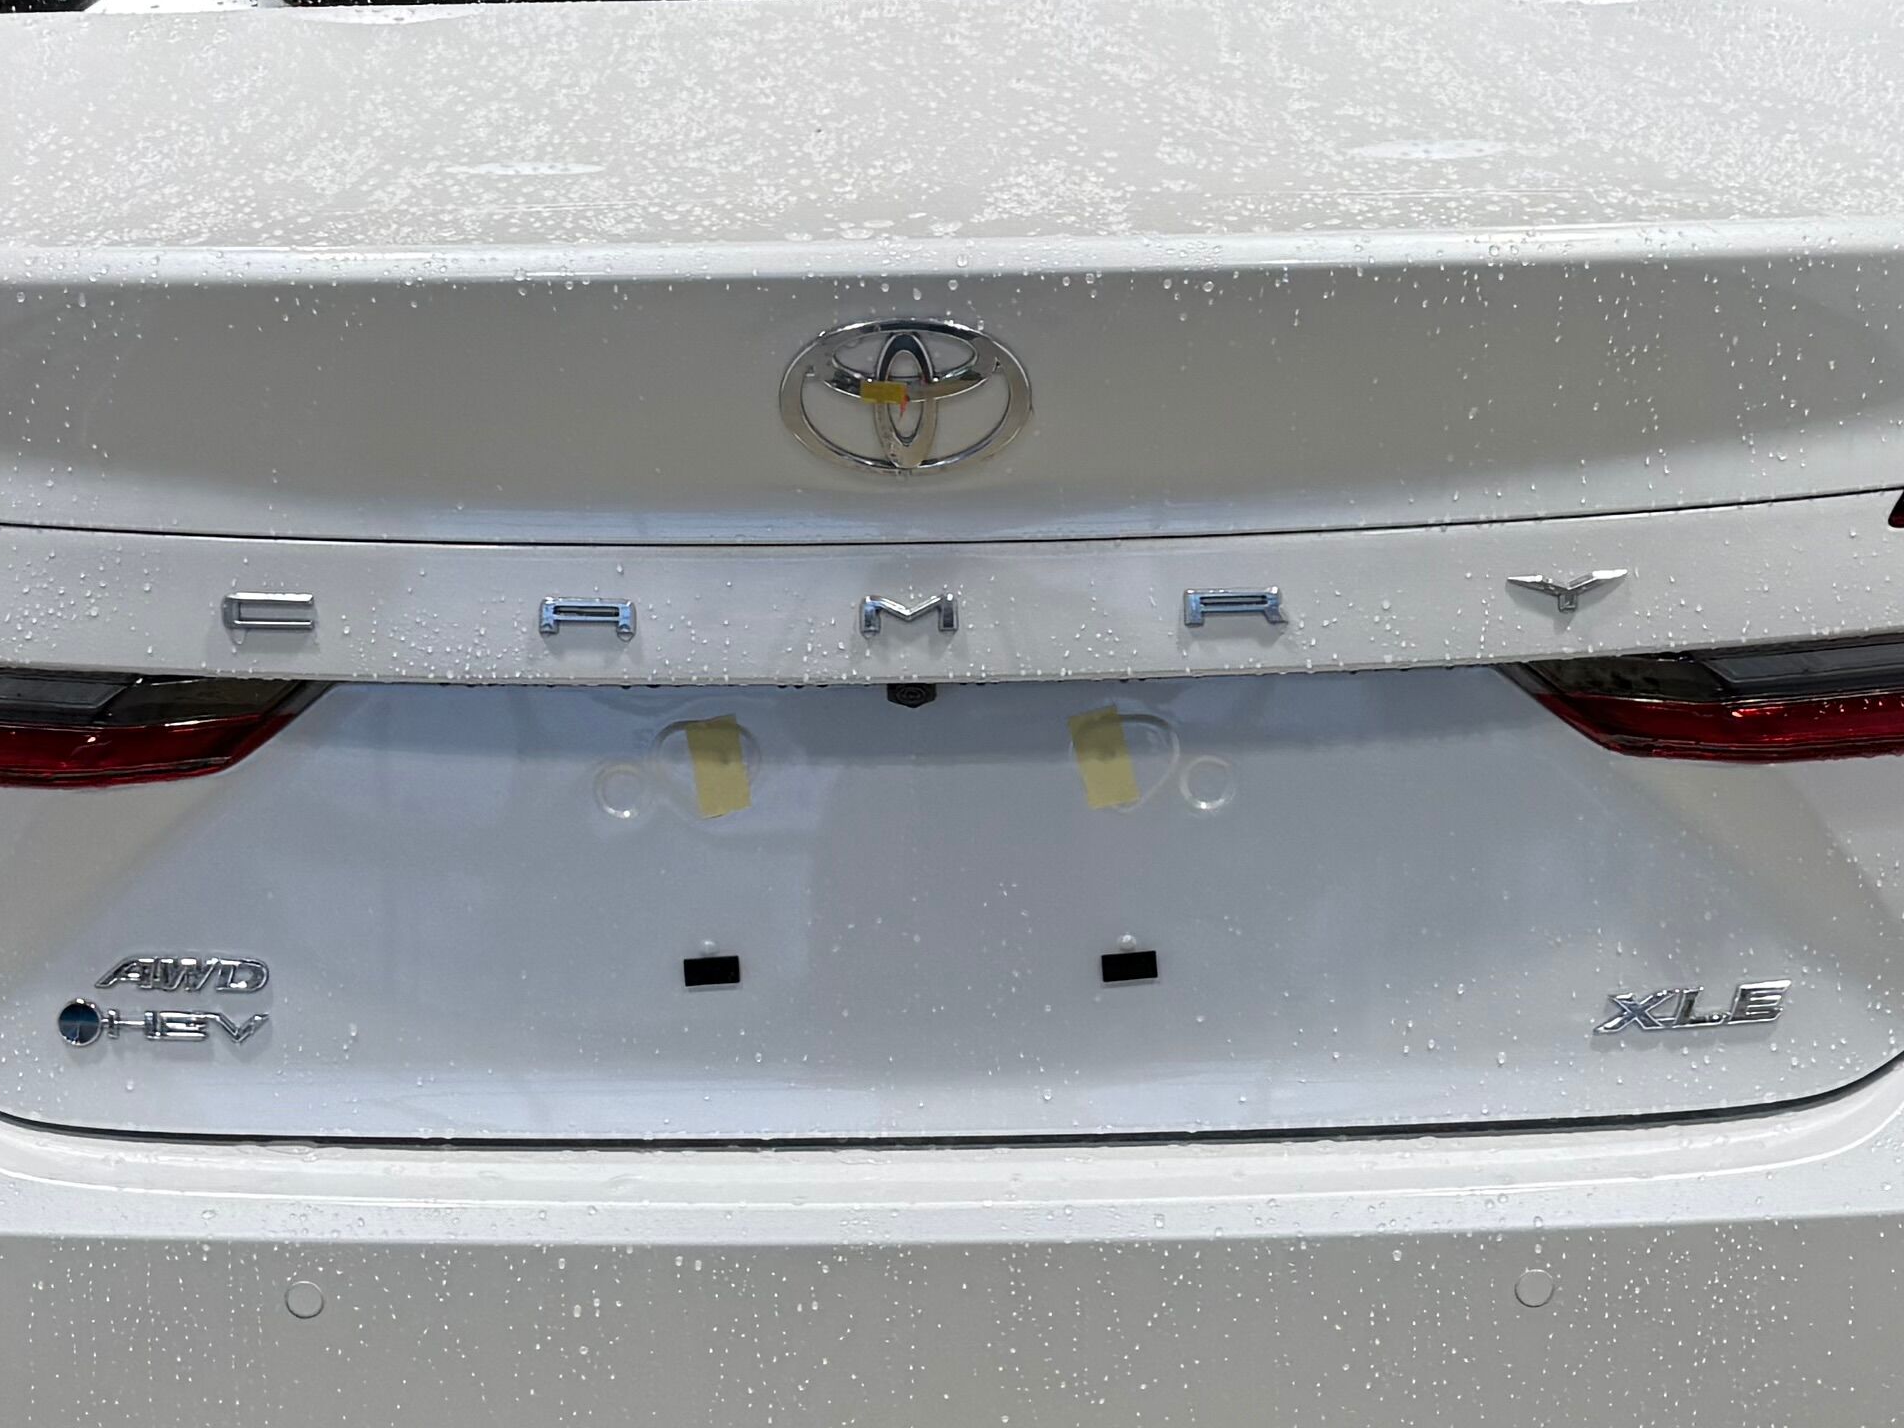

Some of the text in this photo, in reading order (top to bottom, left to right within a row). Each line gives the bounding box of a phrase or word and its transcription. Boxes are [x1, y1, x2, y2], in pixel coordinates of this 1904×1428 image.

[221, 569, 1629, 641] CAMRY
[94, 955, 271, 993] AWD
[104, 1008, 271, 1044] HEV
[1592, 978, 1793, 1036] XLE
